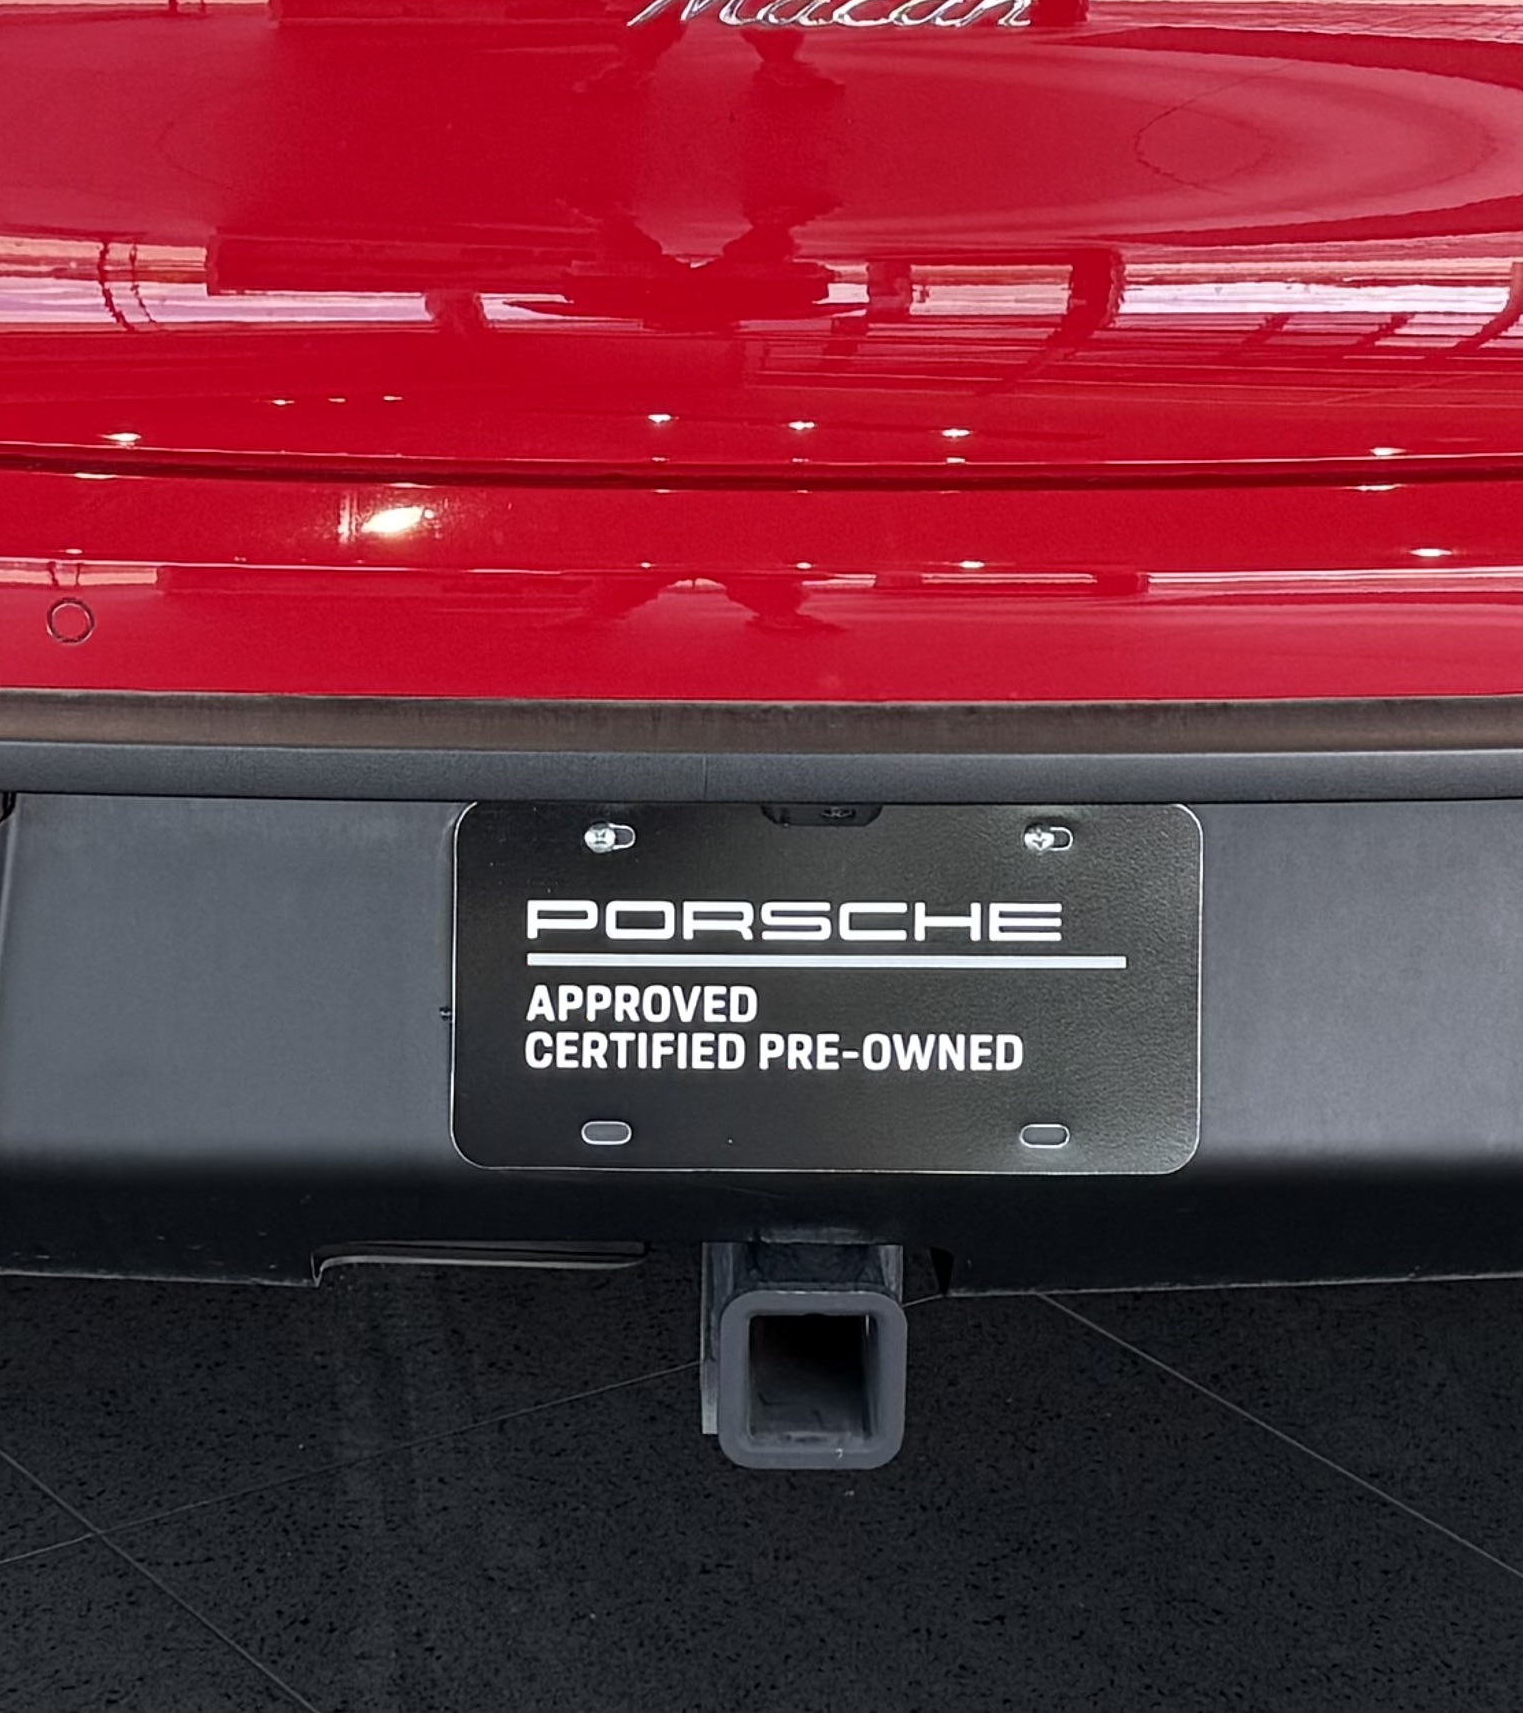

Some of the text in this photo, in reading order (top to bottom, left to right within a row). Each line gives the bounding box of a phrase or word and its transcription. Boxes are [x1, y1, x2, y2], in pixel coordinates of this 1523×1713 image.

[527, 899, 1063, 942] PORSCHE
[526, 984, 758, 1023] APPROVED
[525, 1030, 1024, 1072] CERTIFIED PRE-OWNED
